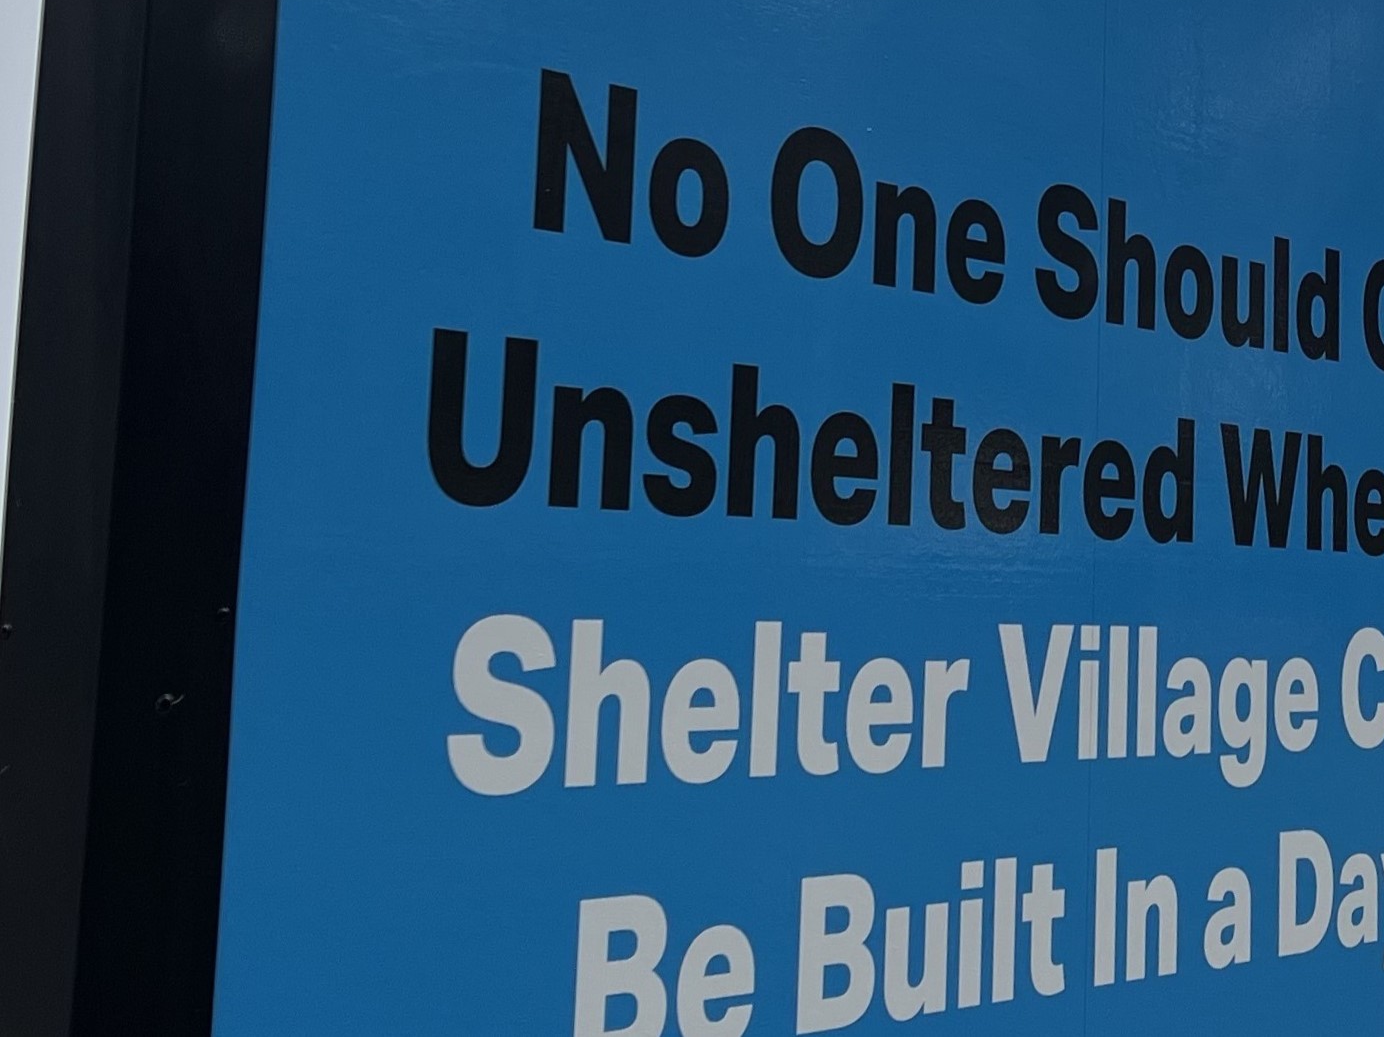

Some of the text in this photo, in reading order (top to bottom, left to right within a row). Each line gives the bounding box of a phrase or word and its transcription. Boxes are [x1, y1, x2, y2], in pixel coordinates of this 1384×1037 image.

[534, 69, 730, 258] No
[771, 127, 1006, 305] One
[1035, 184, 1341, 362] Should
[428, 330, 1194, 544] Unsheltered
[448, 615, 970, 796] Shelter
[999, 624, 1319, 788] Village
[574, 895, 755, 1037] Be
[797, 858, 1065, 1035] Built
[1094, 848, 1178, 987] In
[1204, 868, 1252, 969] a
